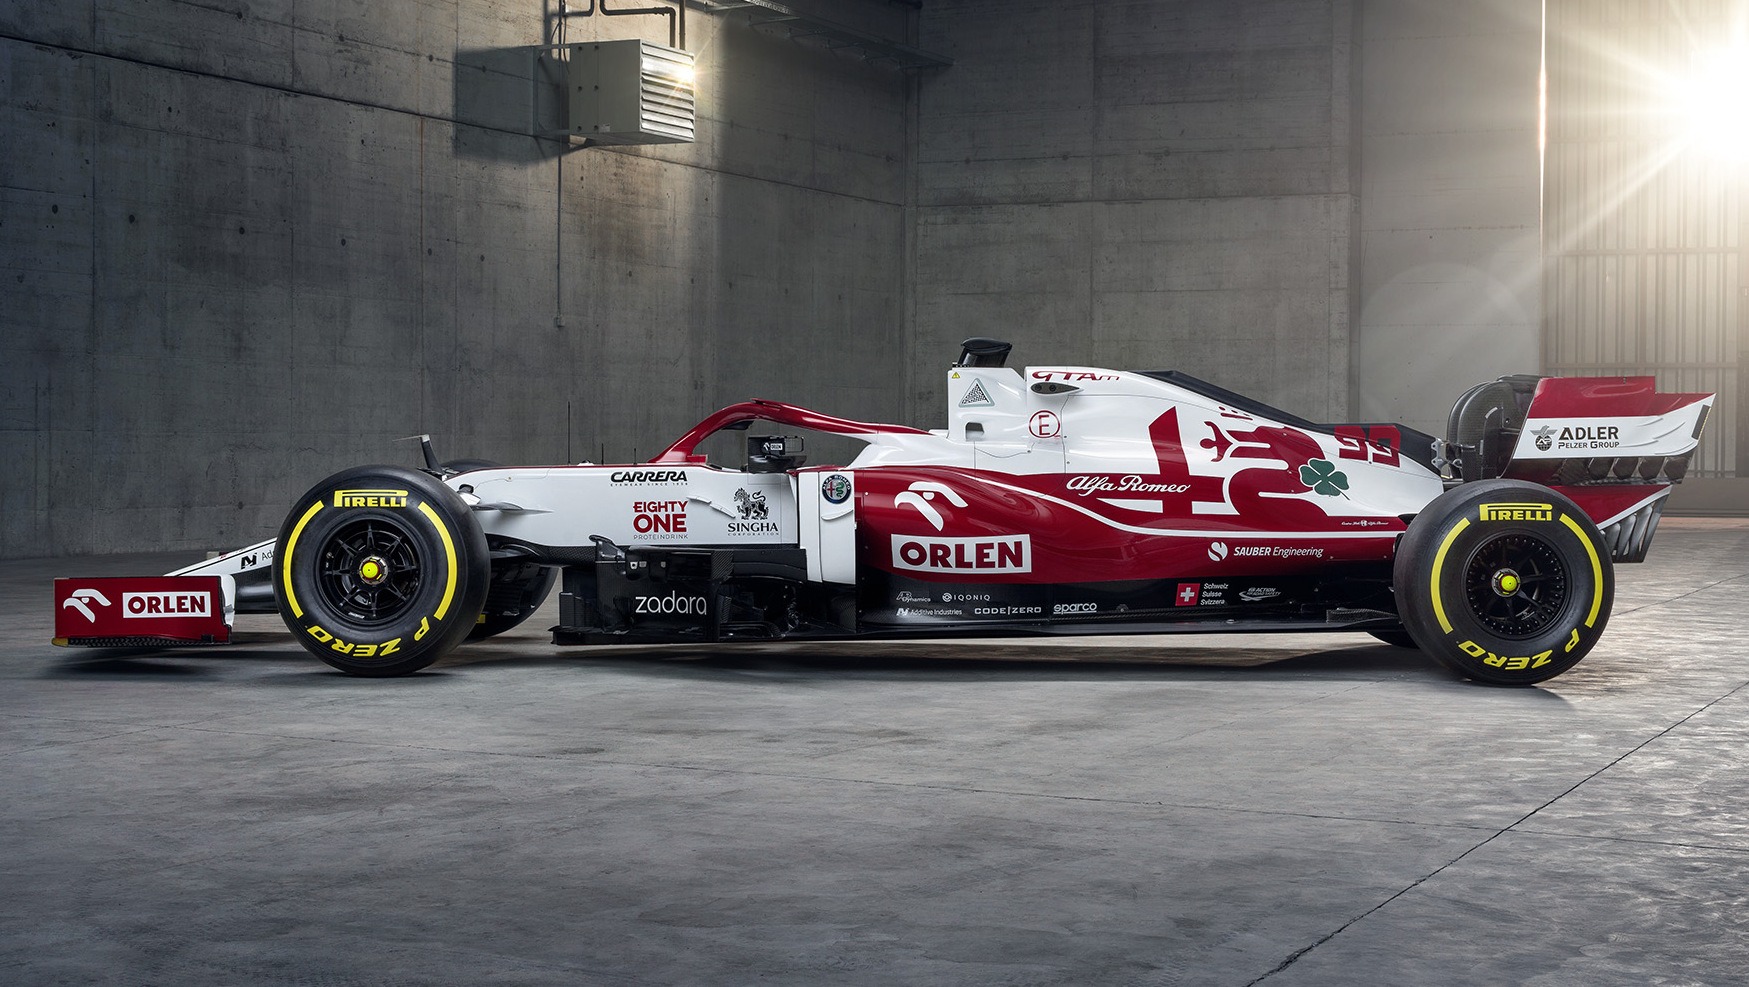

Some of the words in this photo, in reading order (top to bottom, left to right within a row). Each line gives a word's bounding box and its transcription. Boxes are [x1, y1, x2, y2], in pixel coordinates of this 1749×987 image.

[1038, 414, 1051, 435] E
[1558, 427, 1619, 441] ADLER
[1334, 425, 1401, 468] 99
[610, 471, 688, 482] CARRERA
[834, 475, 851, 490] ROMEO
[1066, 475, 1118, 497] Alfa
[1117, 475, 1191, 493] Romeo
[333, 489, 409, 508] PIRELLI
[633, 501, 689, 513] EIGHTY
[1479, 502, 1553, 521] PIRELLI
[633, 513, 688, 534] ONE
[727, 522, 779, 532] SINGHA
[261, 550, 275, 561] Ad
[900, 540, 1024, 569] ORLEN
[1233, 546, 1272, 556] SAUBER
[1272, 546, 1324, 559] Engineering
[1201, 590, 1223, 598] Suisse
[1203, 582, 1229, 590] Schweiz
[128, 595, 206, 615] ORLEN
[635, 590, 707, 615] zadara
[953, 594, 991, 602] IQONIQ
[1200, 598, 1226, 606] Svizzera
[1053, 602, 1097, 614] sparco
[414, 616, 430, 641] P
[306, 625, 402, 657] ZERO
[1565, 628, 1580, 653] P
[1458, 640, 1553, 670] ZERO
